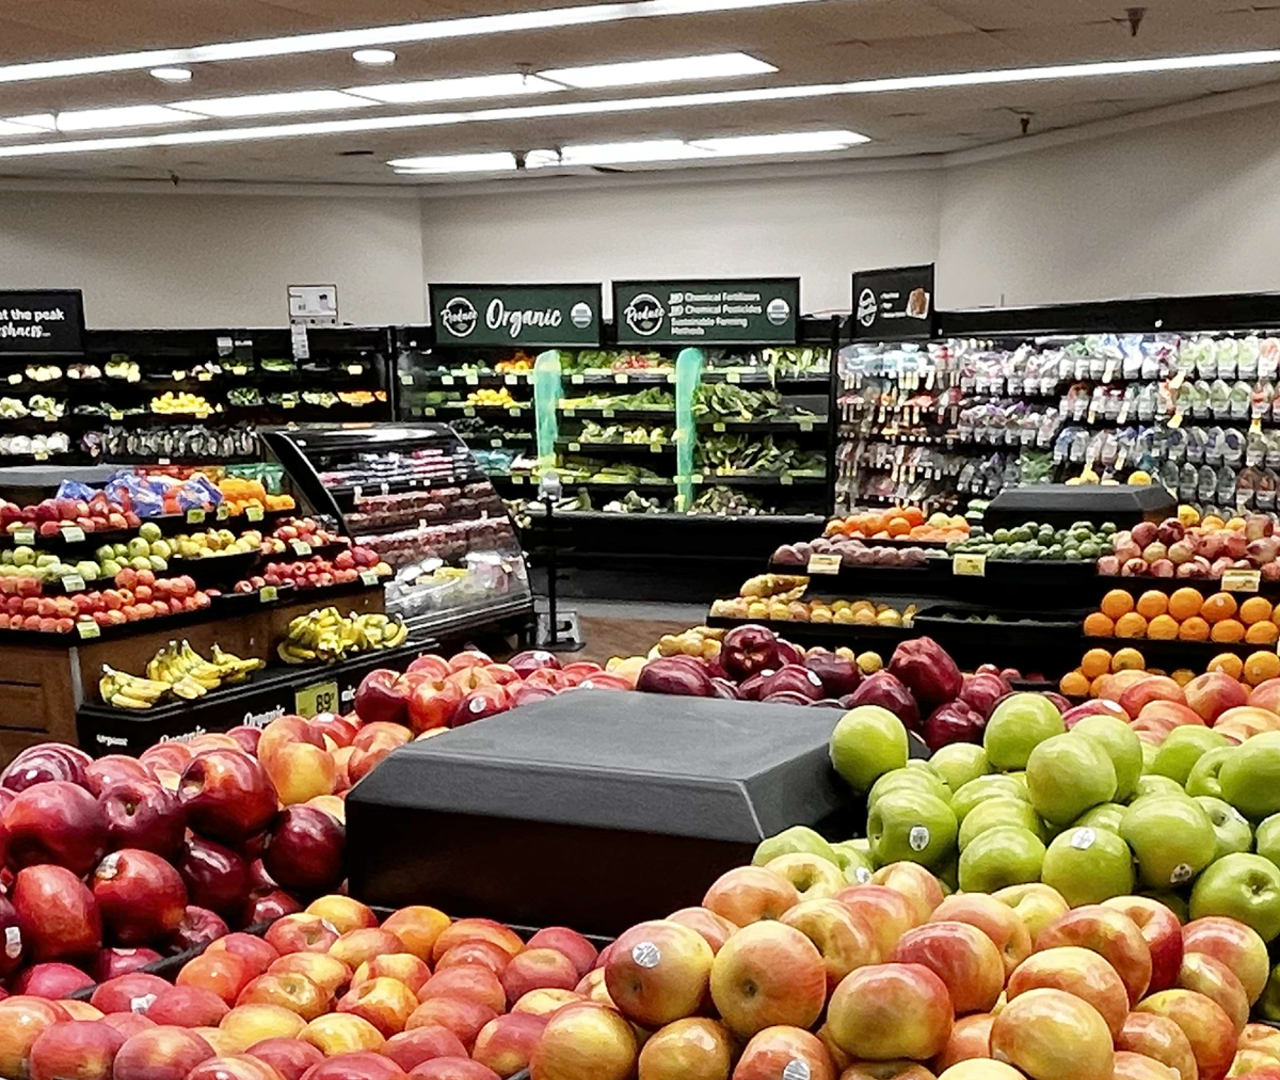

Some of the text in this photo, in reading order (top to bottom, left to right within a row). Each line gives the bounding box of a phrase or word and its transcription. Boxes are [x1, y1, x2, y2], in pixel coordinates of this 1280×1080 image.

[10, 308, 32, 320] the
[33, 308, 65, 322] peak
[485, 298, 563, 338] Organic
